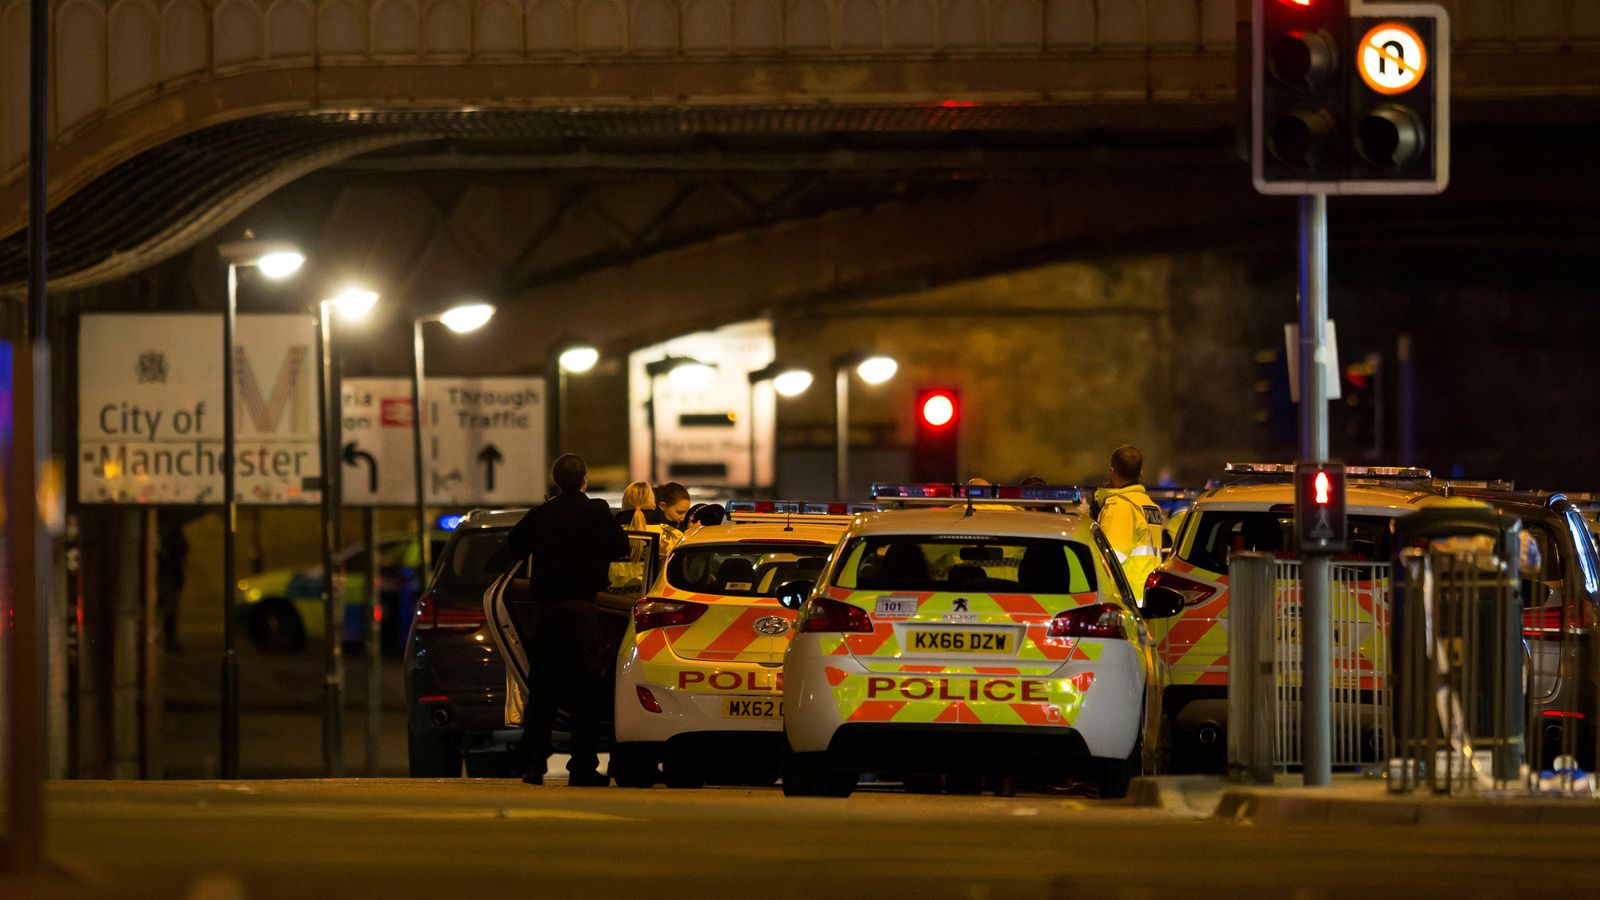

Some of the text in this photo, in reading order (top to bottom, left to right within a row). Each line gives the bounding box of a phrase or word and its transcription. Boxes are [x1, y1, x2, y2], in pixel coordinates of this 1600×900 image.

[448, 388, 538, 408] Through
[100, 401, 206, 441] City of
[342, 416, 371, 431] on
[458, 411, 529, 429] Traffic
[884, 602, 902, 611] 101
[915, 632, 1007, 650] KX66 DZW
[678, 671, 784, 691] POLI
[867, 677, 1049, 702] POLICE
[729, 701, 774, 717] MX62
